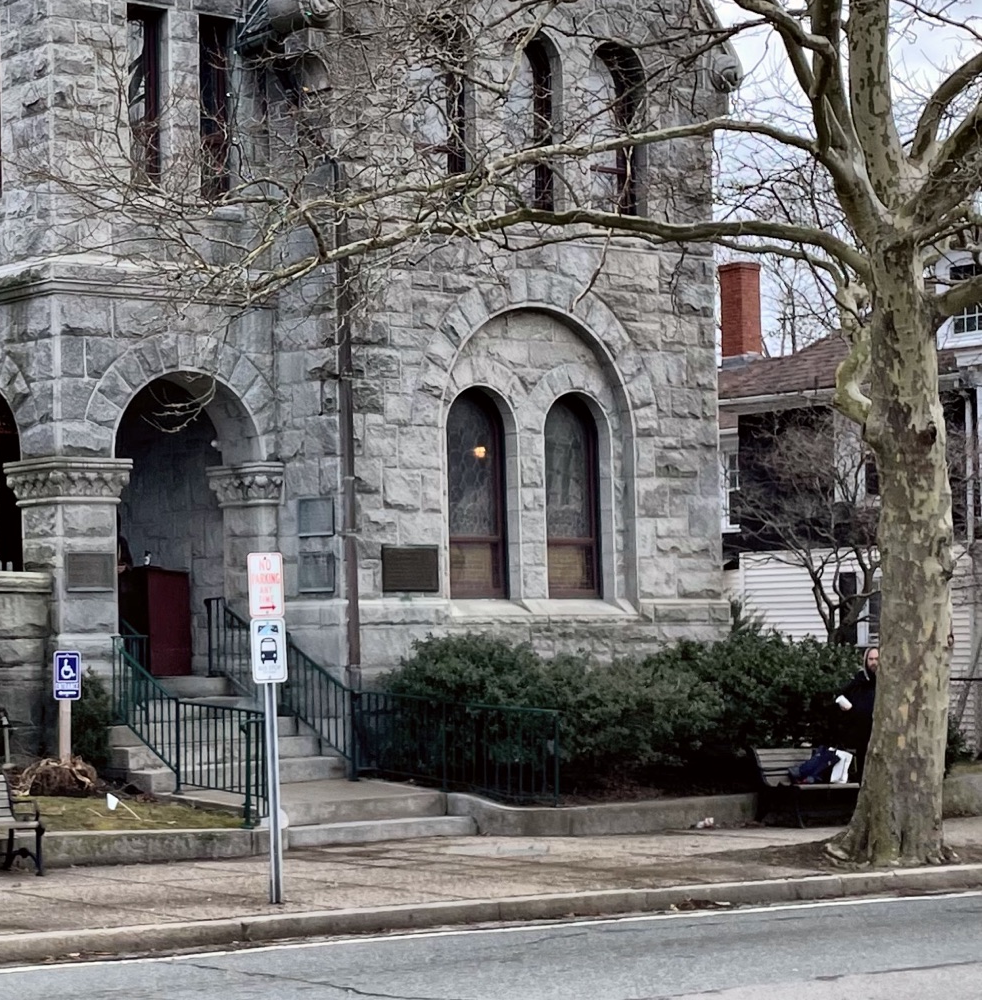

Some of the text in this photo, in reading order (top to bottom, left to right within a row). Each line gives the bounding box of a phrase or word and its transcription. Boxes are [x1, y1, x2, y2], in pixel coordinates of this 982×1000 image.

[259, 559, 272, 571] NO
[250, 572, 281, 584] PARKING
[260, 586, 272, 594] ANY
